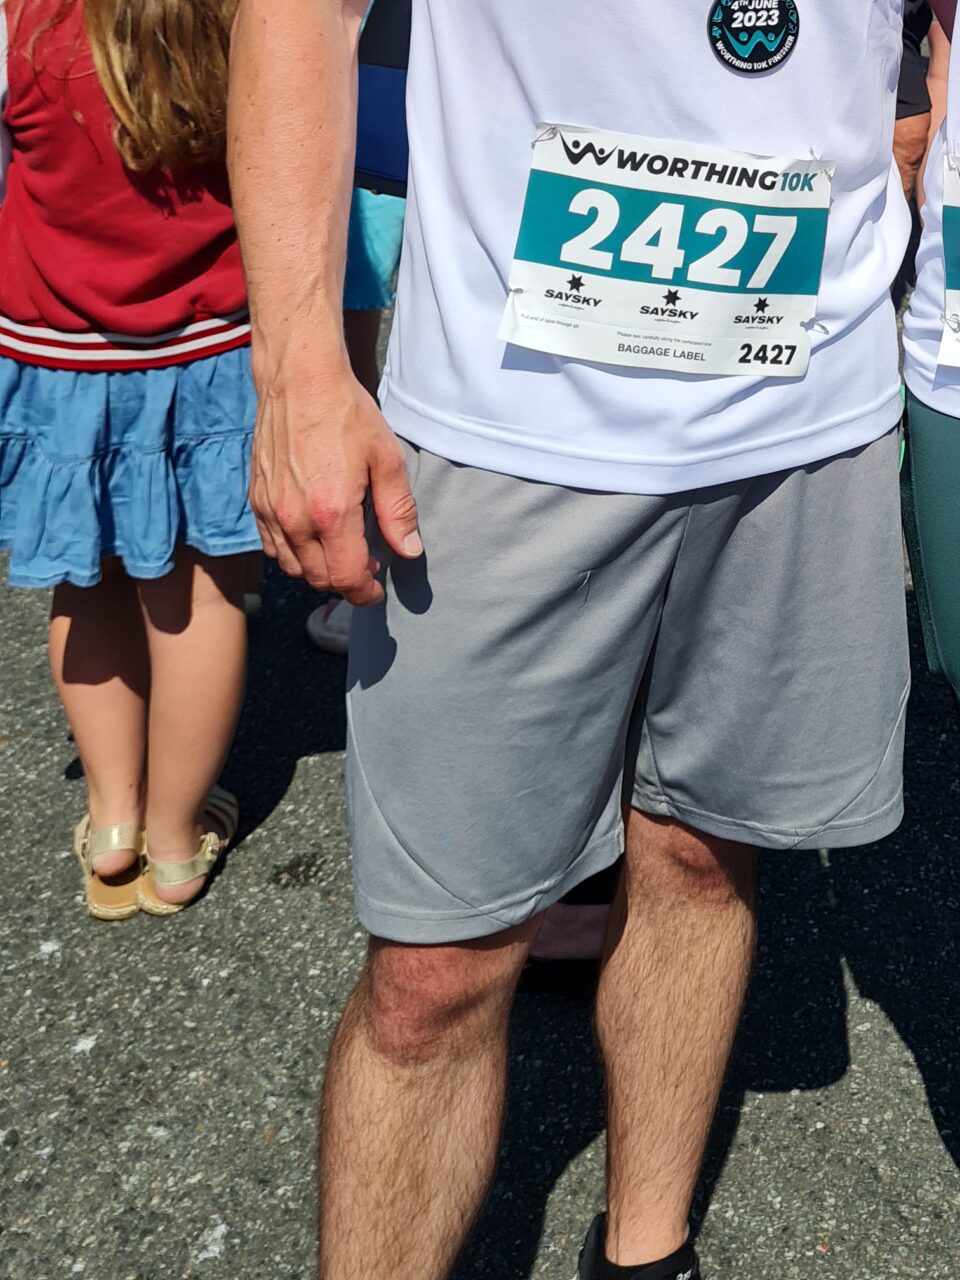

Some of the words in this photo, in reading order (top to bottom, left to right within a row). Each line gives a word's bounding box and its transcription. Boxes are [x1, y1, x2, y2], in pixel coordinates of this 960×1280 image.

[731, 9, 780, 28] 2023
[716, 40, 753, 70] WORTHING
[753, 60, 769, 70] 10K
[768, 34, 795, 66] FINISHER
[617, 148, 779, 192] WORTHING
[779, 172, 819, 193] 10K
[559, 188, 798, 290] 2427
[544, 289, 603, 308] SAYSKY
[639, 305, 699, 321] SAYSKY
[733, 314, 784, 326] SAYSKY
[618, 343, 670, 357] BAGGAGE
[673, 348, 706, 361] LABEL
[738, 343, 797, 365] 2427
